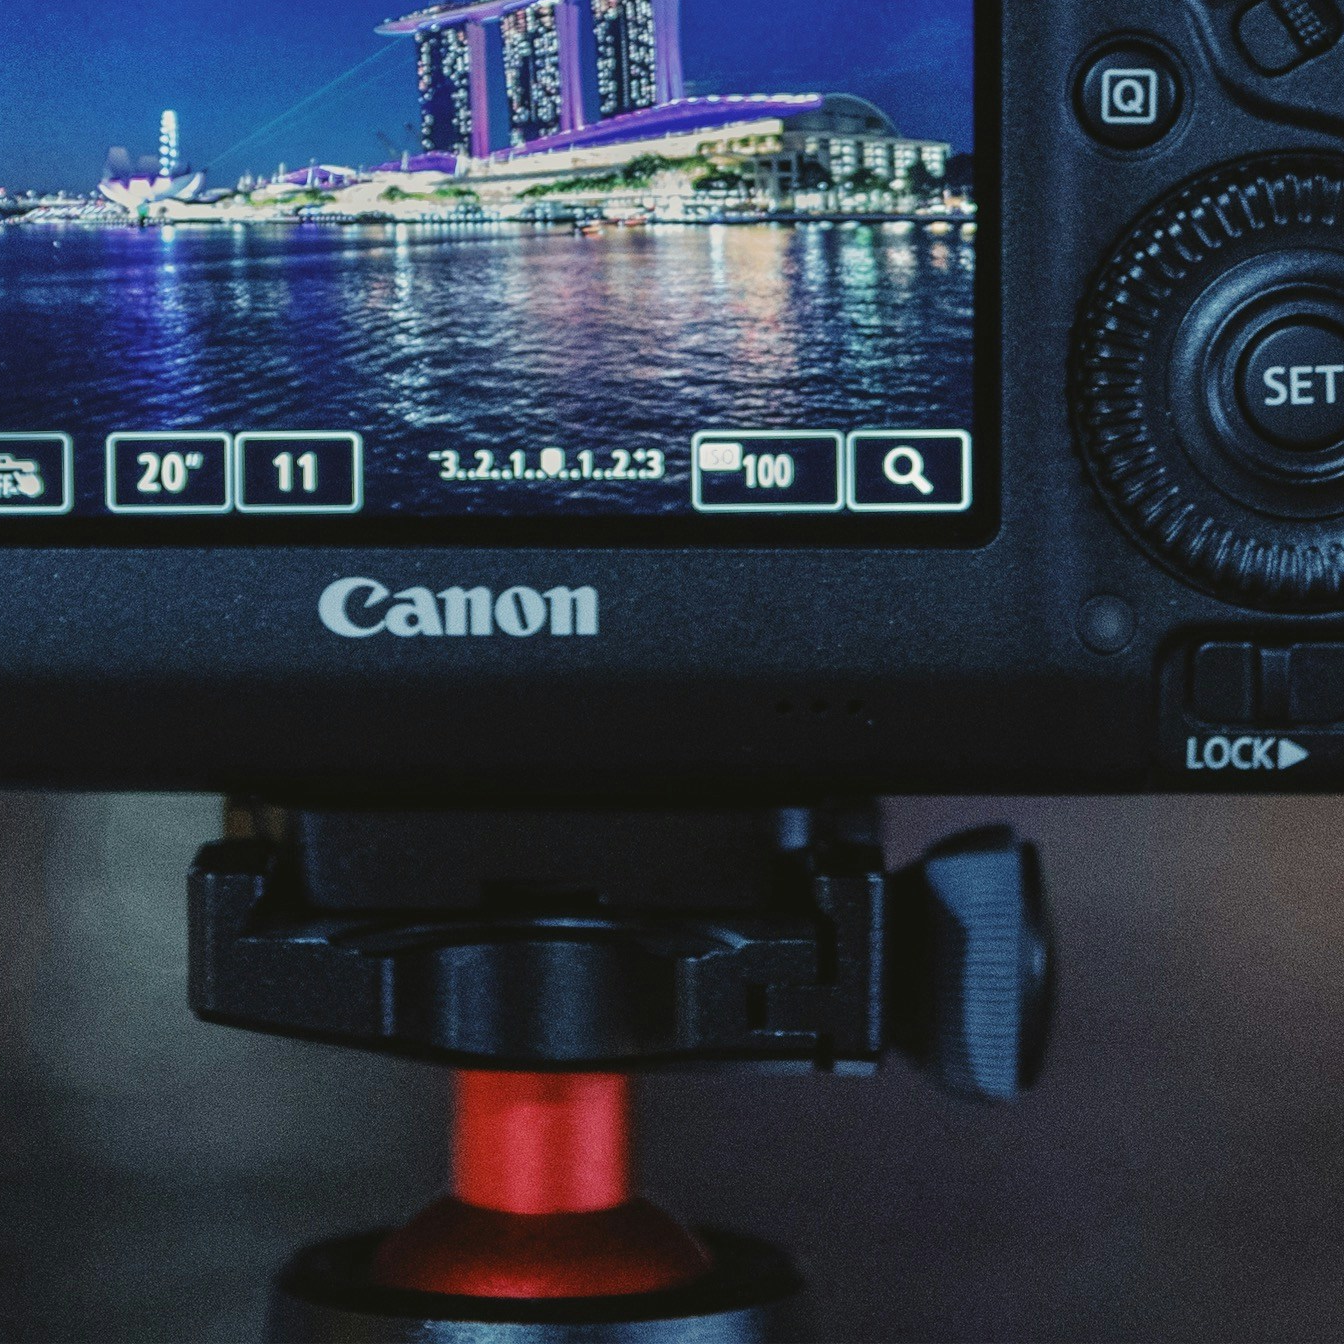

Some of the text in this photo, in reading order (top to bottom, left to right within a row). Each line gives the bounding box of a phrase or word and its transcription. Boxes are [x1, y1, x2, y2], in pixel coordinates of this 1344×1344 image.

[1112, 79, 1144, 112] Q
[273, 452, 318, 493] 11
[742, 454, 795, 489] 100
[318, 577, 599, 638] Canon
[1186, 737, 1276, 770] LOCK
